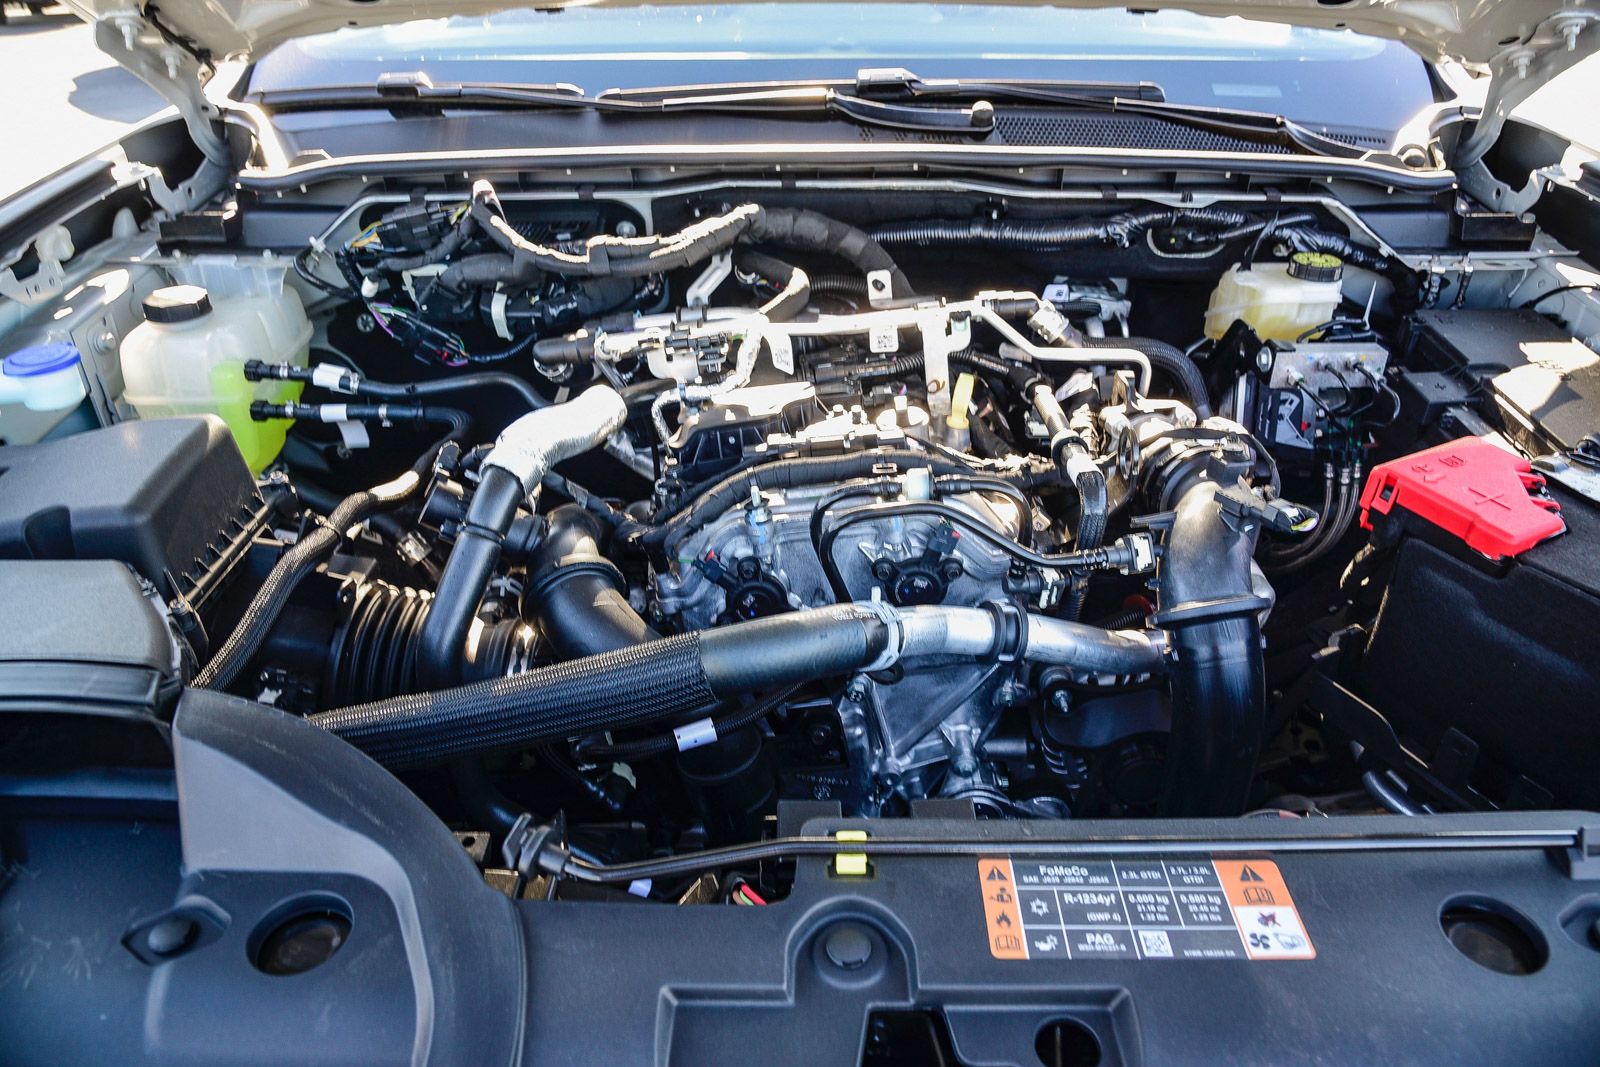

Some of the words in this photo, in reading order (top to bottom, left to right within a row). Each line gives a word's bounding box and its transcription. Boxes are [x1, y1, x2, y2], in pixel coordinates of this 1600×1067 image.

[1039, 865, 1088, 876] FoMoCo
[1064, 893, 1116, 906] R-1234yf
[1156, 894, 1170, 905] kg
[1207, 894, 1222, 905] kg
[1086, 933, 1114, 945] PAG
